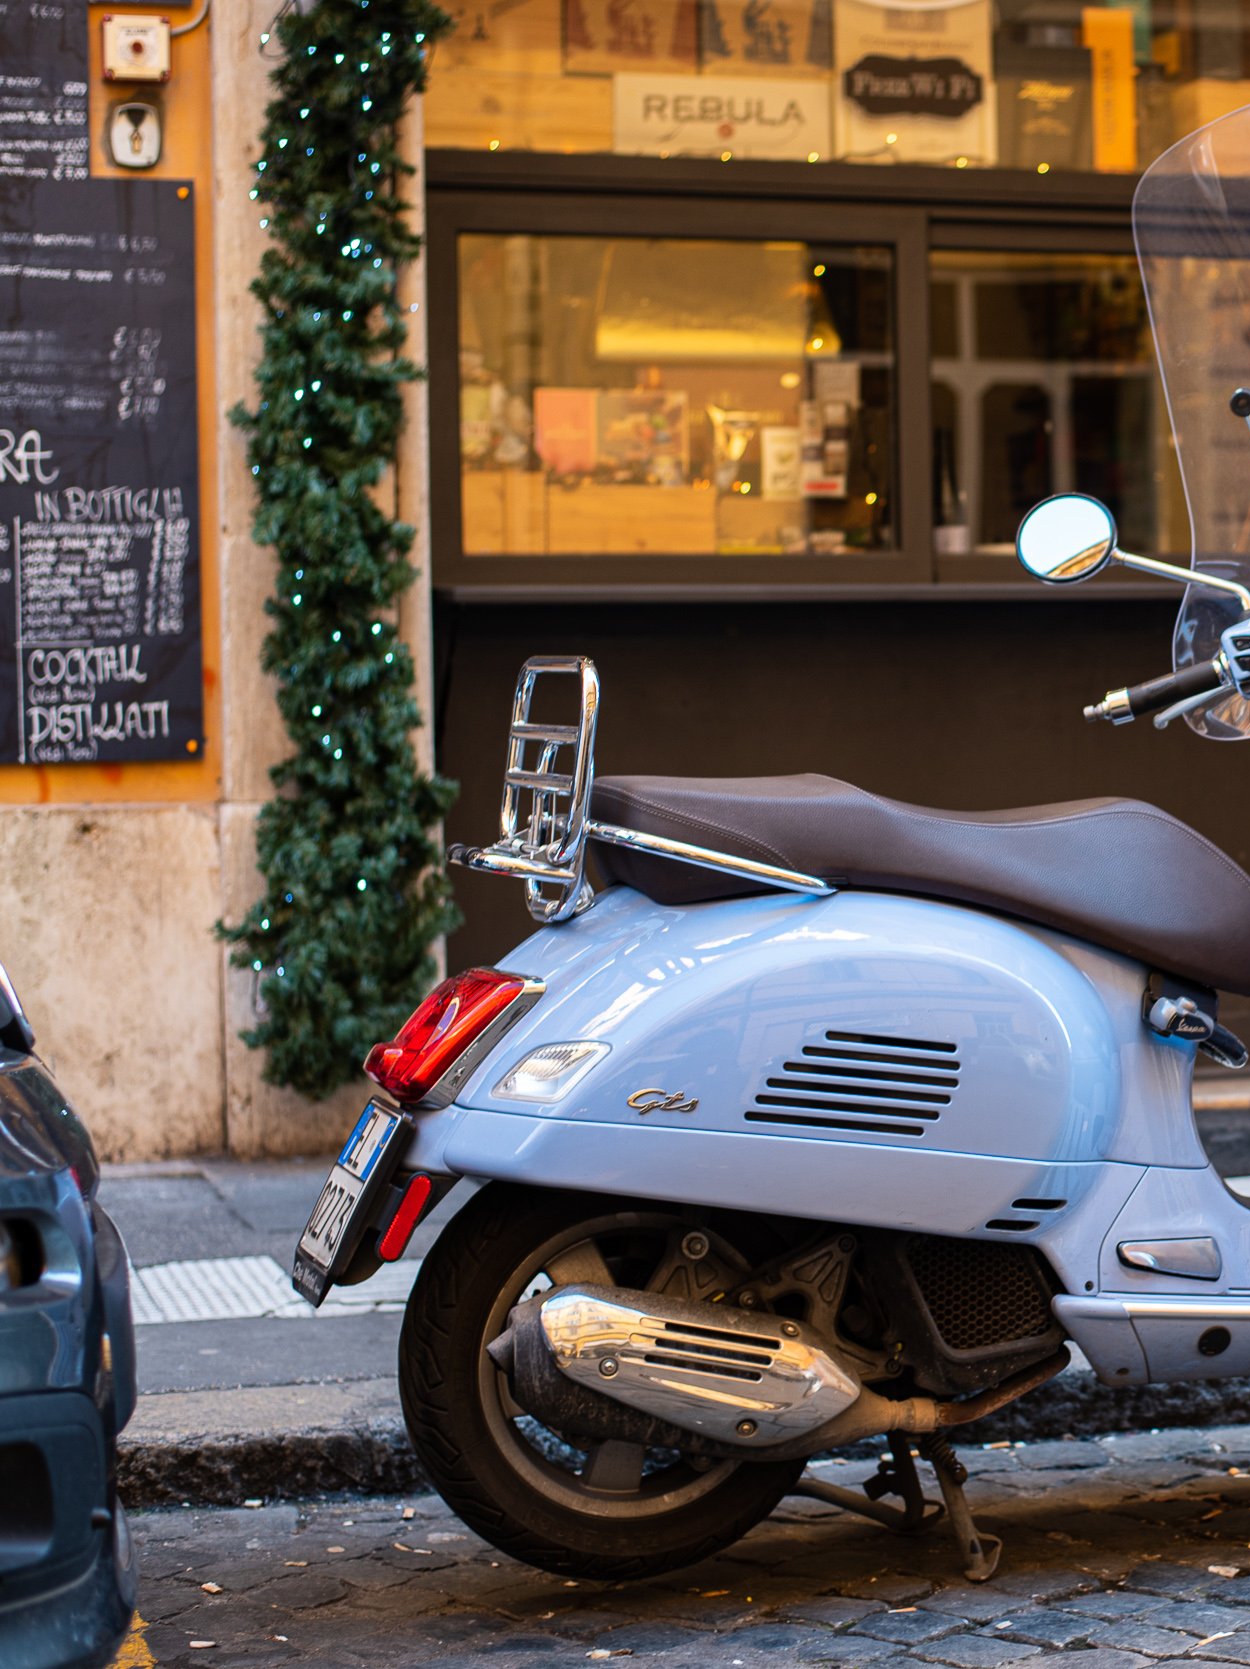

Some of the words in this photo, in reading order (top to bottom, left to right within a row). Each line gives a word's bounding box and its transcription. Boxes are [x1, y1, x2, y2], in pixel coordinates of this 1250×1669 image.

[642, 93, 806, 126] REBULA
[34, 489, 62, 522] IN
[26, 700, 170, 743] DISTILLATI
[1175, 1017, 1207, 1033] Vespa
[626, 1087, 699, 1115] Gts
[347, 1111, 379, 1170] EL
[307, 1180, 356, 1252] 02743
